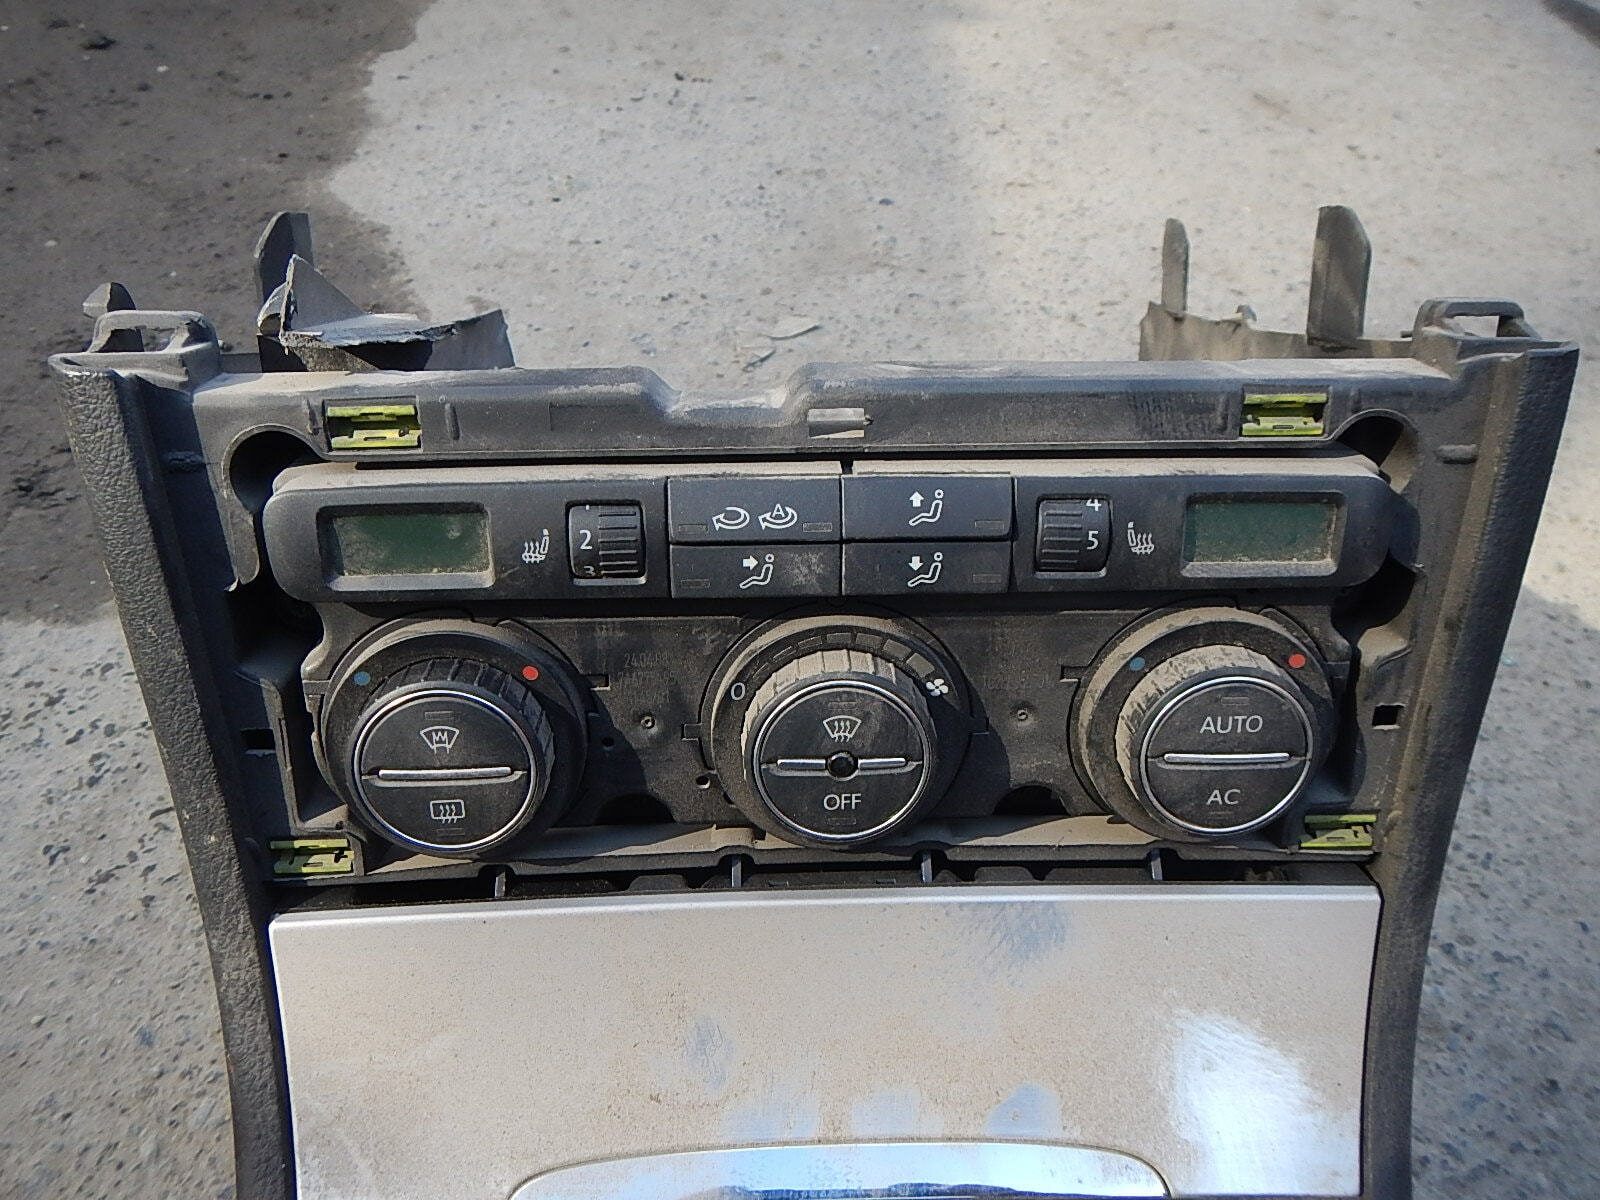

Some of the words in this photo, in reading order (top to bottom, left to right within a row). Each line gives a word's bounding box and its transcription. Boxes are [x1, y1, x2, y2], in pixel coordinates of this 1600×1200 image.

[771, 503, 786, 518] A
[579, 529, 593, 550] 2
[1086, 529, 1099, 551] 5
[1199, 714, 1263, 734] AUTO
[823, 793, 862, 810] OFF
[1206, 788, 1241, 805] AC
